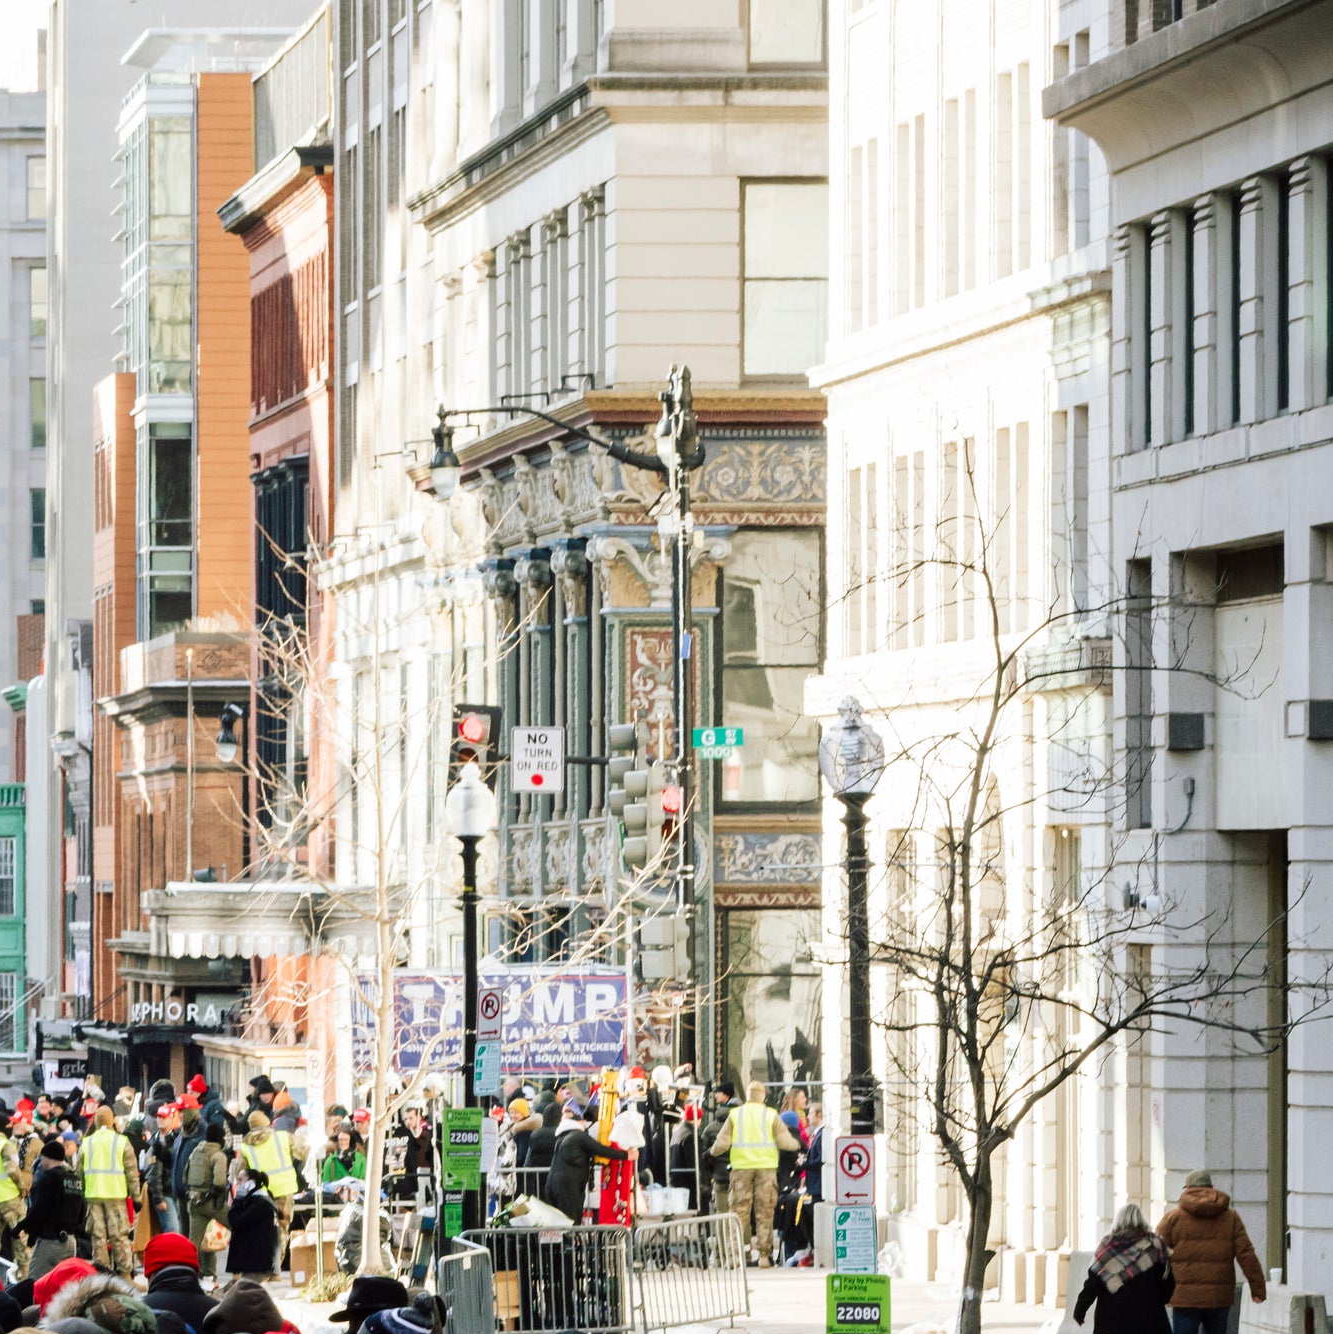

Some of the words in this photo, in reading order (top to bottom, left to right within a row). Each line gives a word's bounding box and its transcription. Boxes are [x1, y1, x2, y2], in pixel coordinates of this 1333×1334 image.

[527, 733, 548, 744] NO
[701, 730, 716, 746] G
[524, 748, 552, 758] TURN
[517, 761, 531, 771] ON
[537, 761, 558, 771] RED
[62, 1061, 86, 1076] grk
[837, 1307, 880, 1320] 22080
